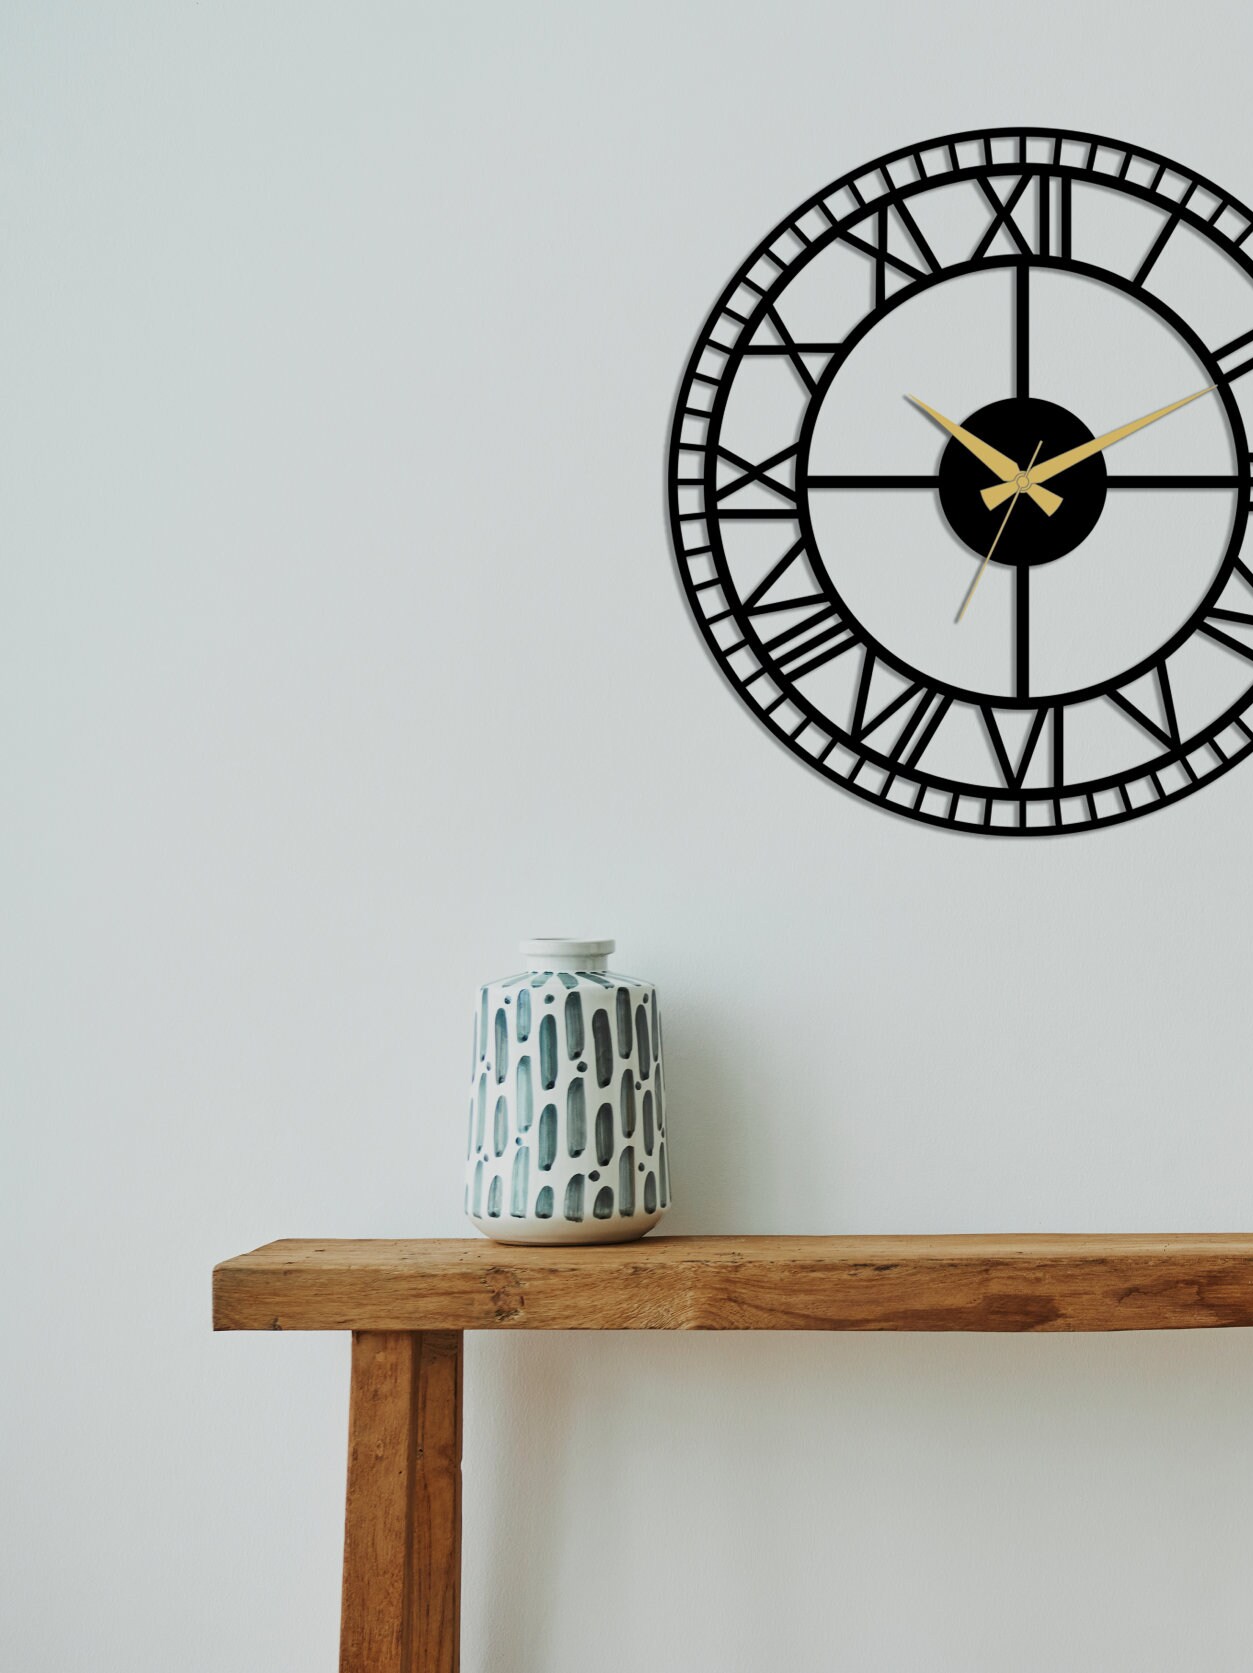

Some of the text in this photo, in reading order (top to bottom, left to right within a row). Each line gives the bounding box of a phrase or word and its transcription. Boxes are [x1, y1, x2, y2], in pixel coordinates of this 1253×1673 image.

[839, 200, 942, 307] XI
[974, 174, 1072, 259] XII
[1133, 215, 1182, 286] I
[745, 308, 843, 395] X
[717, 443, 799, 519] IX
[742, 539, 860, 680] VIII
[852, 654, 951, 766] VII
[1109, 662, 1180, 748] V
[983, 707, 1063, 790] VI
